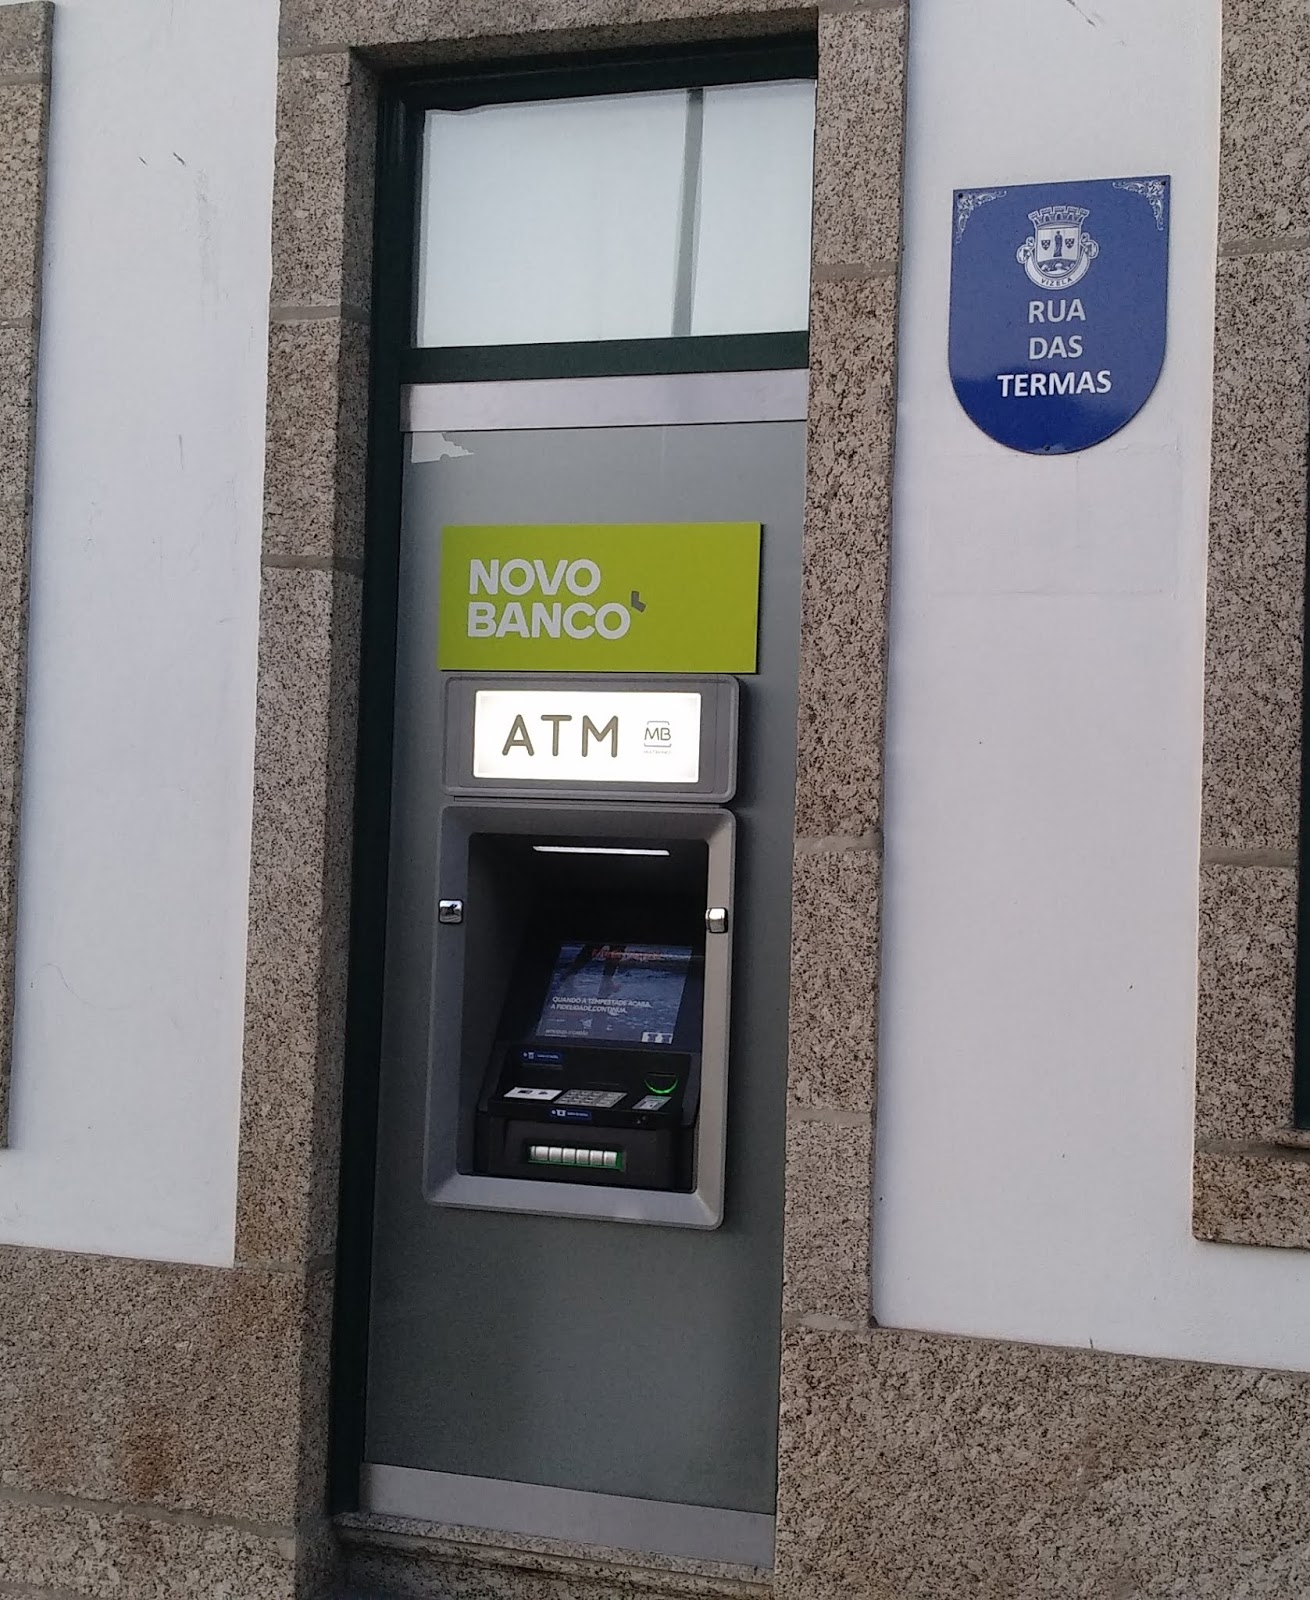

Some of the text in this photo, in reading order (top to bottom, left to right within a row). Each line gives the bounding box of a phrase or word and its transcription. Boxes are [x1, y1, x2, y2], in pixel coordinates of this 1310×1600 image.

[1041, 277, 1073, 287] VIZELA
[1028, 299, 1086, 323] RUA
[1029, 335, 1083, 360] DAS
[997, 370, 1112, 397] TERMAS
[469, 558, 601, 597] NOVO
[467, 602, 631, 640] BANCO
[501, 714, 619, 758] ATM
[644, 727, 672, 741] MB
[552, 996, 582, 1004] QUANDO
